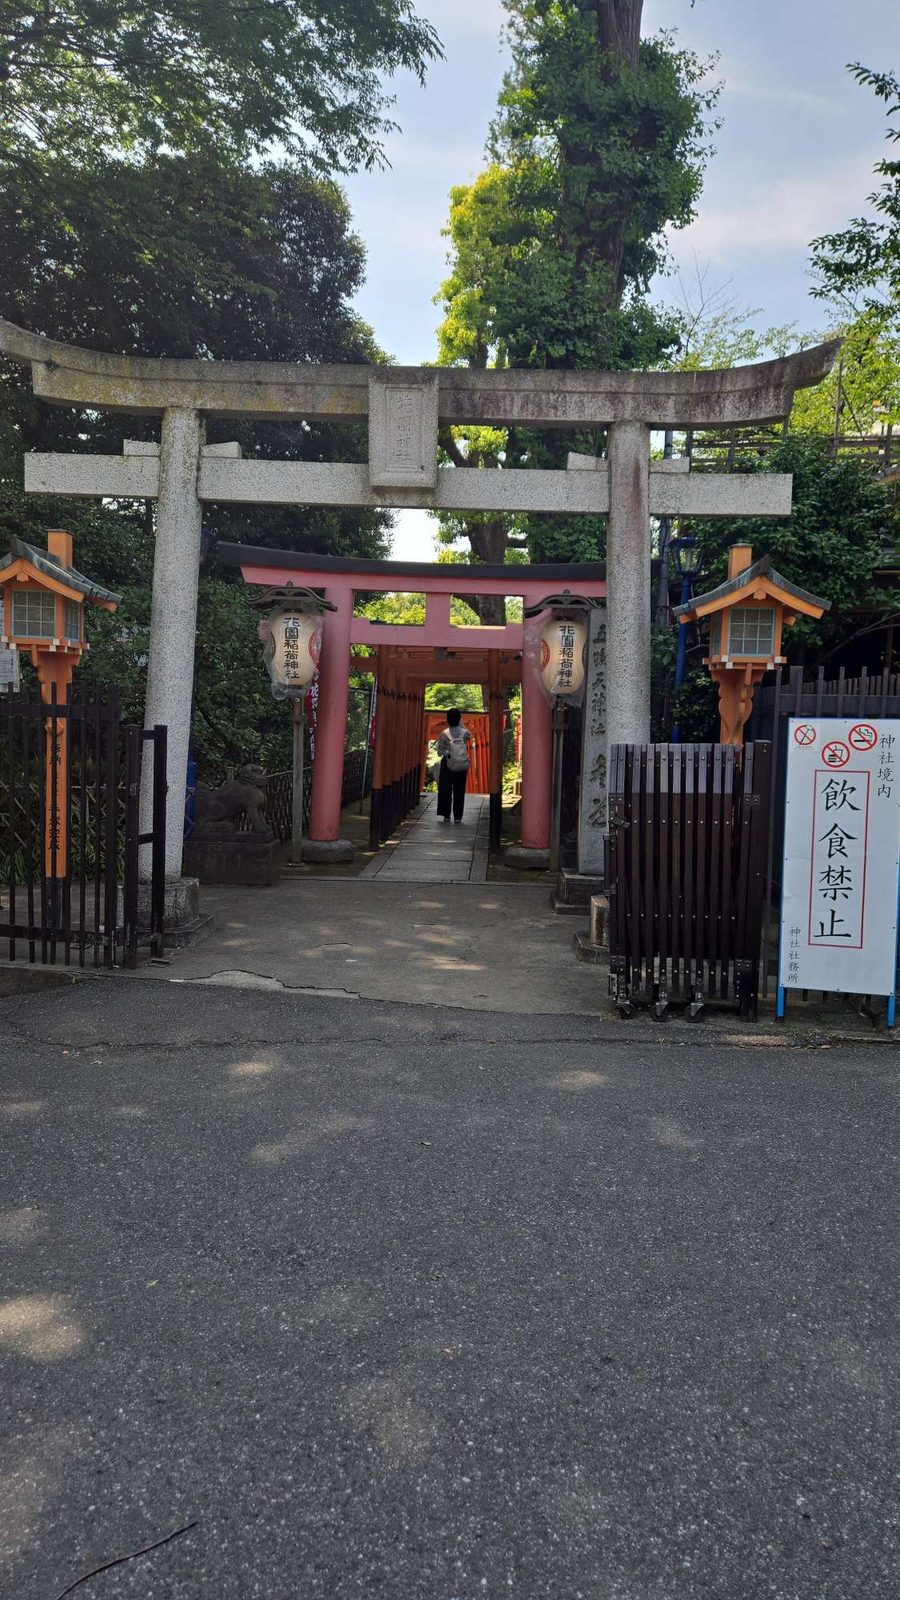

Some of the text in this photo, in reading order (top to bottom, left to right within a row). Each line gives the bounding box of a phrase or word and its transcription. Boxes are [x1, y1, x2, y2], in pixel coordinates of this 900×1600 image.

[283, 617, 300, 679] 花園稲荷神社
[558, 625, 575, 688] 花園稲荷神社
[877, 734, 896, 798] 神社境内
[813, 778, 862, 938] 飲食禁止
[787, 926, 801, 983] 神社社務所
